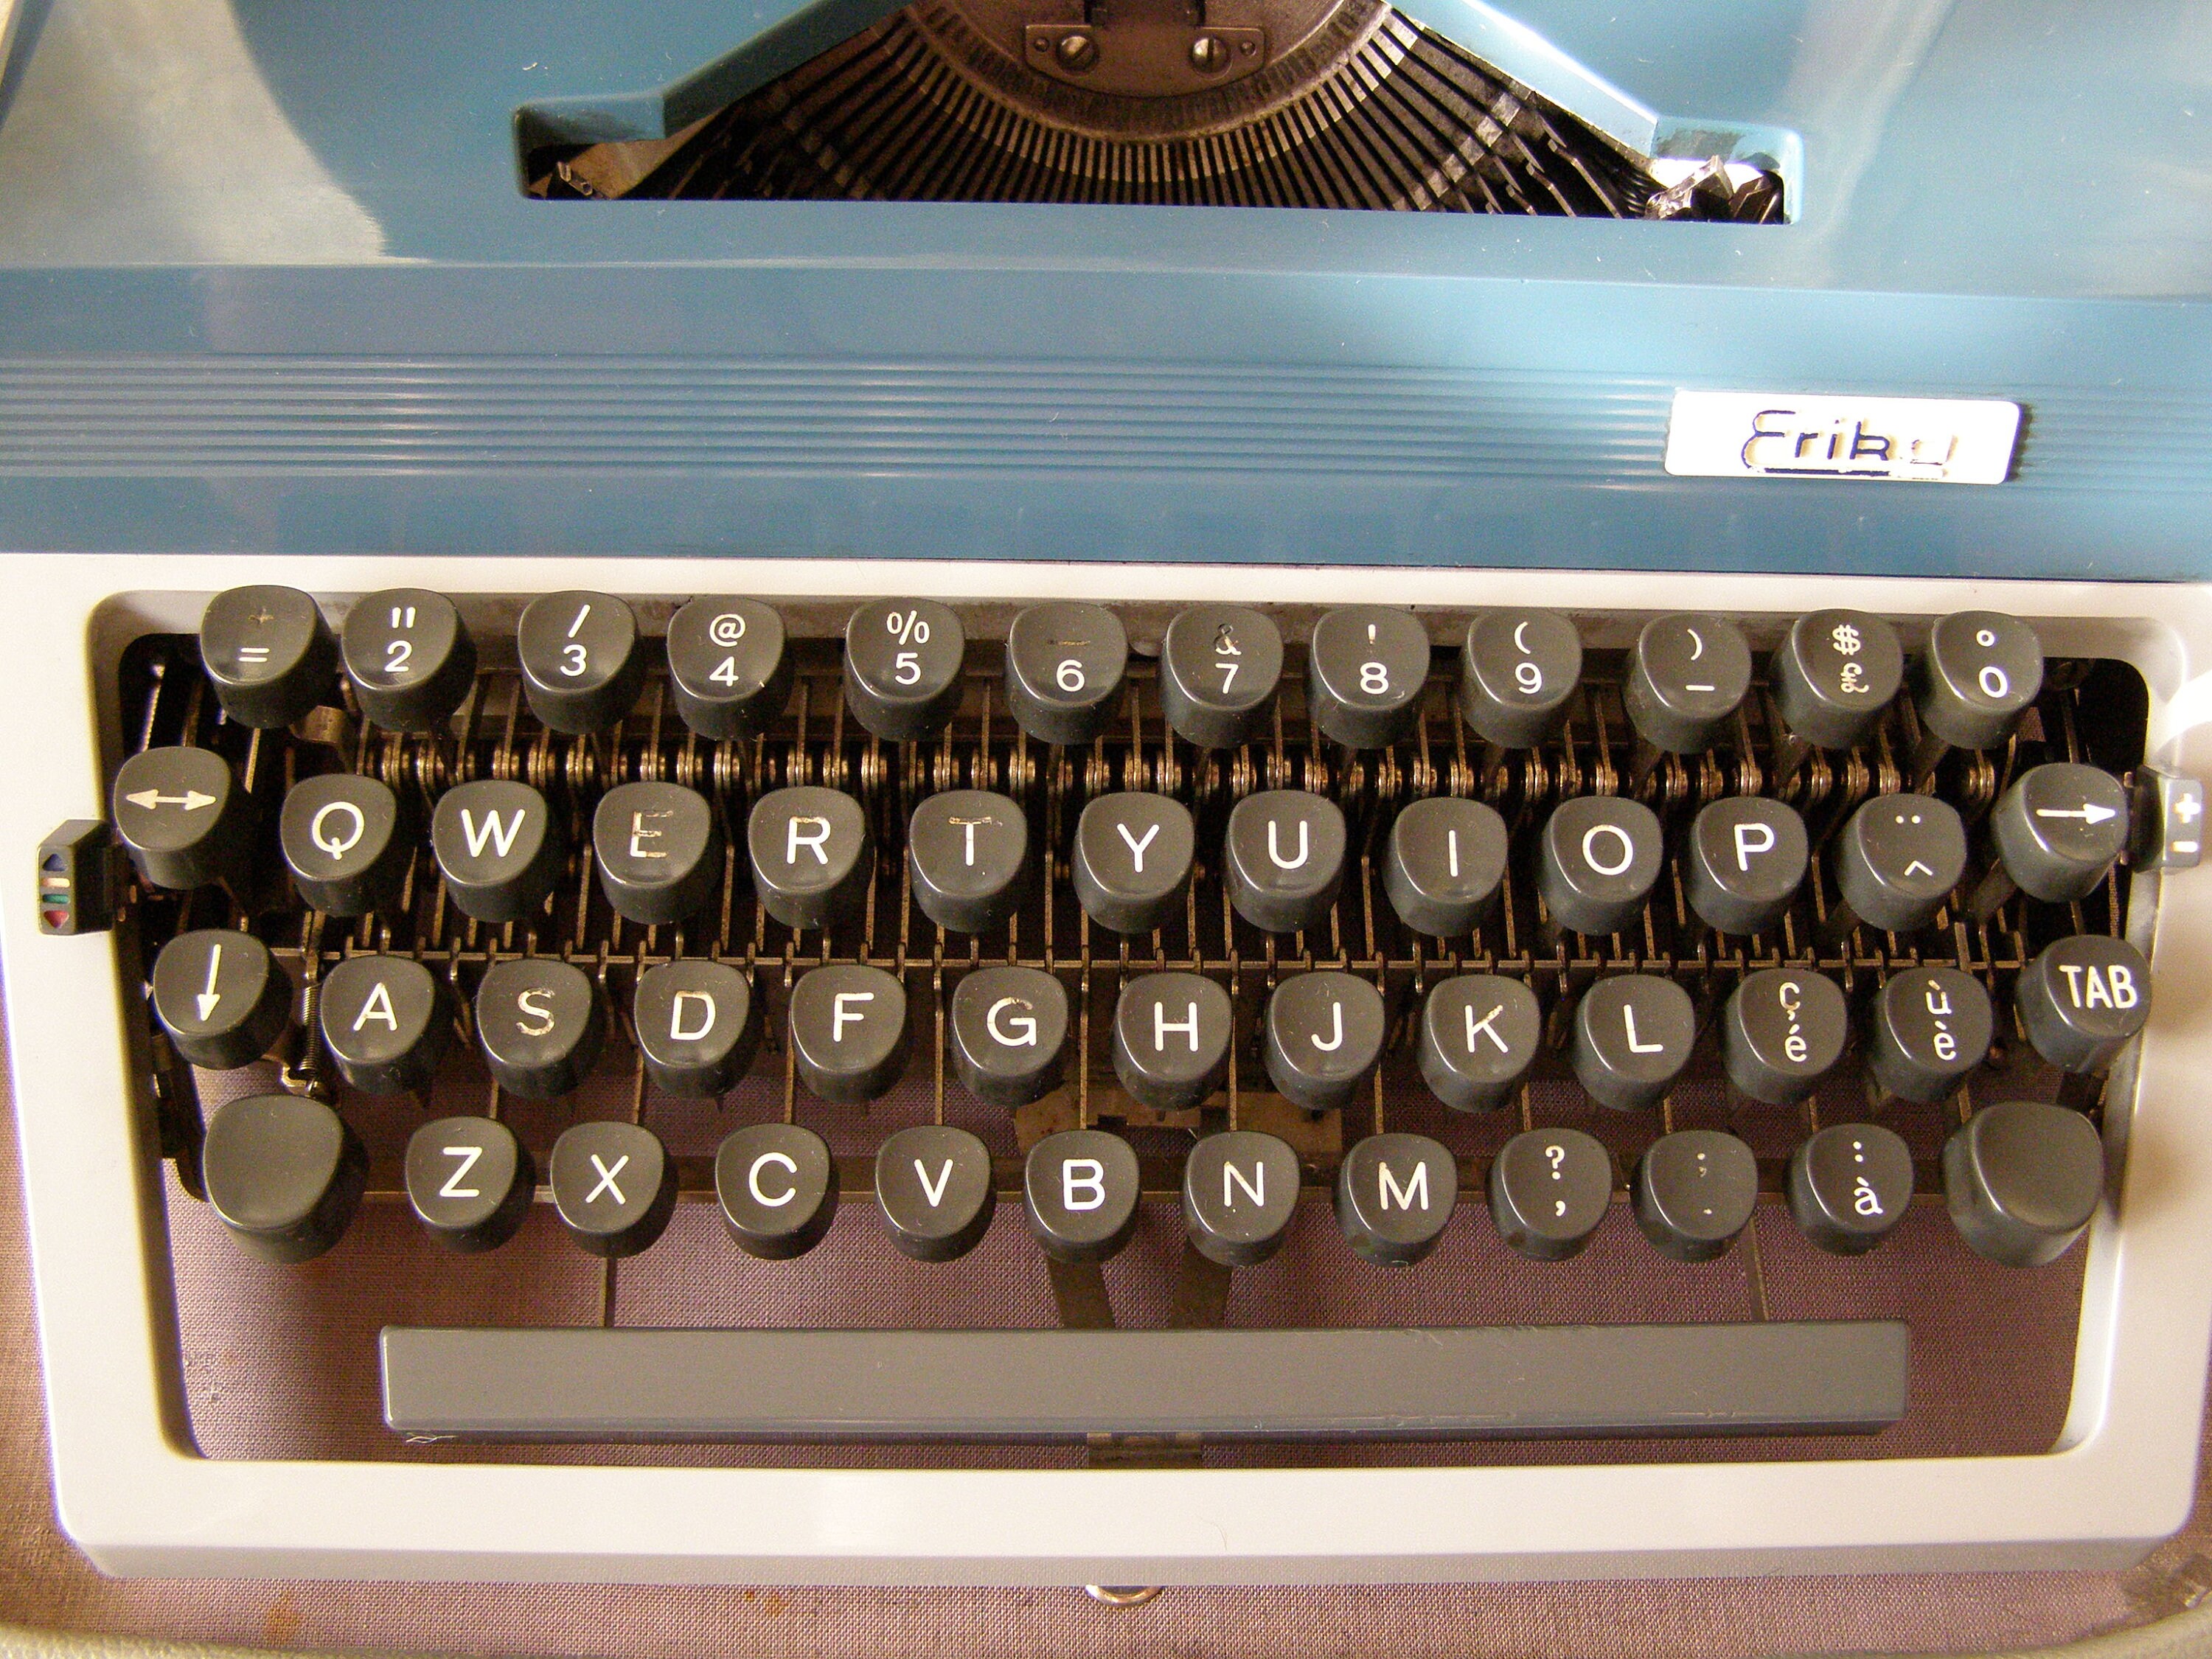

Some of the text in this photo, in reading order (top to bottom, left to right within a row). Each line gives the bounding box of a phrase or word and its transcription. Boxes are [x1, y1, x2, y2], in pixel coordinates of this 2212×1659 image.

[709, 613, 746, 647] @
[886, 610, 930, 645] %
[1832, 624, 1861, 656] $
[384, 640, 412, 672] 2
[560, 644, 587, 677] 3
[709, 655, 740, 687] 4
[894, 652, 922, 685] 5
[1056, 659, 1085, 692] 6
[1215, 662, 1239, 694] 7
[1360, 661, 1389, 695] 8
[1514, 662, 1543, 695] 9
[311, 801, 365, 860] Q
[461, 809, 526, 858] W
[629, 808, 674, 859] E
[786, 816, 831, 865] R
[949, 816, 992, 866] T
[1116, 823, 1160, 873] Y
[1267, 820, 1309, 869] U
[1448, 830, 1458, 877] I
[1582, 824, 1634, 876] O
[1733, 822, 1775, 872] P
[352, 982, 398, 1032] A
[1925, 979, 1952, 1015] ù
[2059, 964, 2138, 1010] TAB
[516, 989, 555, 1037] S
[669, 990, 716, 1040] D
[832, 992, 874, 1043] F
[987, 996, 1037, 1046] G
[1154, 1001, 1199, 1052] H
[1311, 1001, 1343, 1051] J
[1464, 1004, 1509, 1054] K
[1623, 1004, 1664, 1053] L
[1784, 1023, 1807, 1062] é
[1933, 1020, 1957, 1061] è
[439, 1146, 483, 1197] Z
[585, 1154, 629, 1205] X
[748, 1152, 798, 1207] C
[914, 1158, 953, 1208] V
[1062, 1158, 1106, 1211] B
[1223, 1161, 1265, 1207] N
[1378, 1161, 1429, 1211] M
[1545, 1145, 1565, 1180] ?
[1854, 1176, 1884, 1215] à
